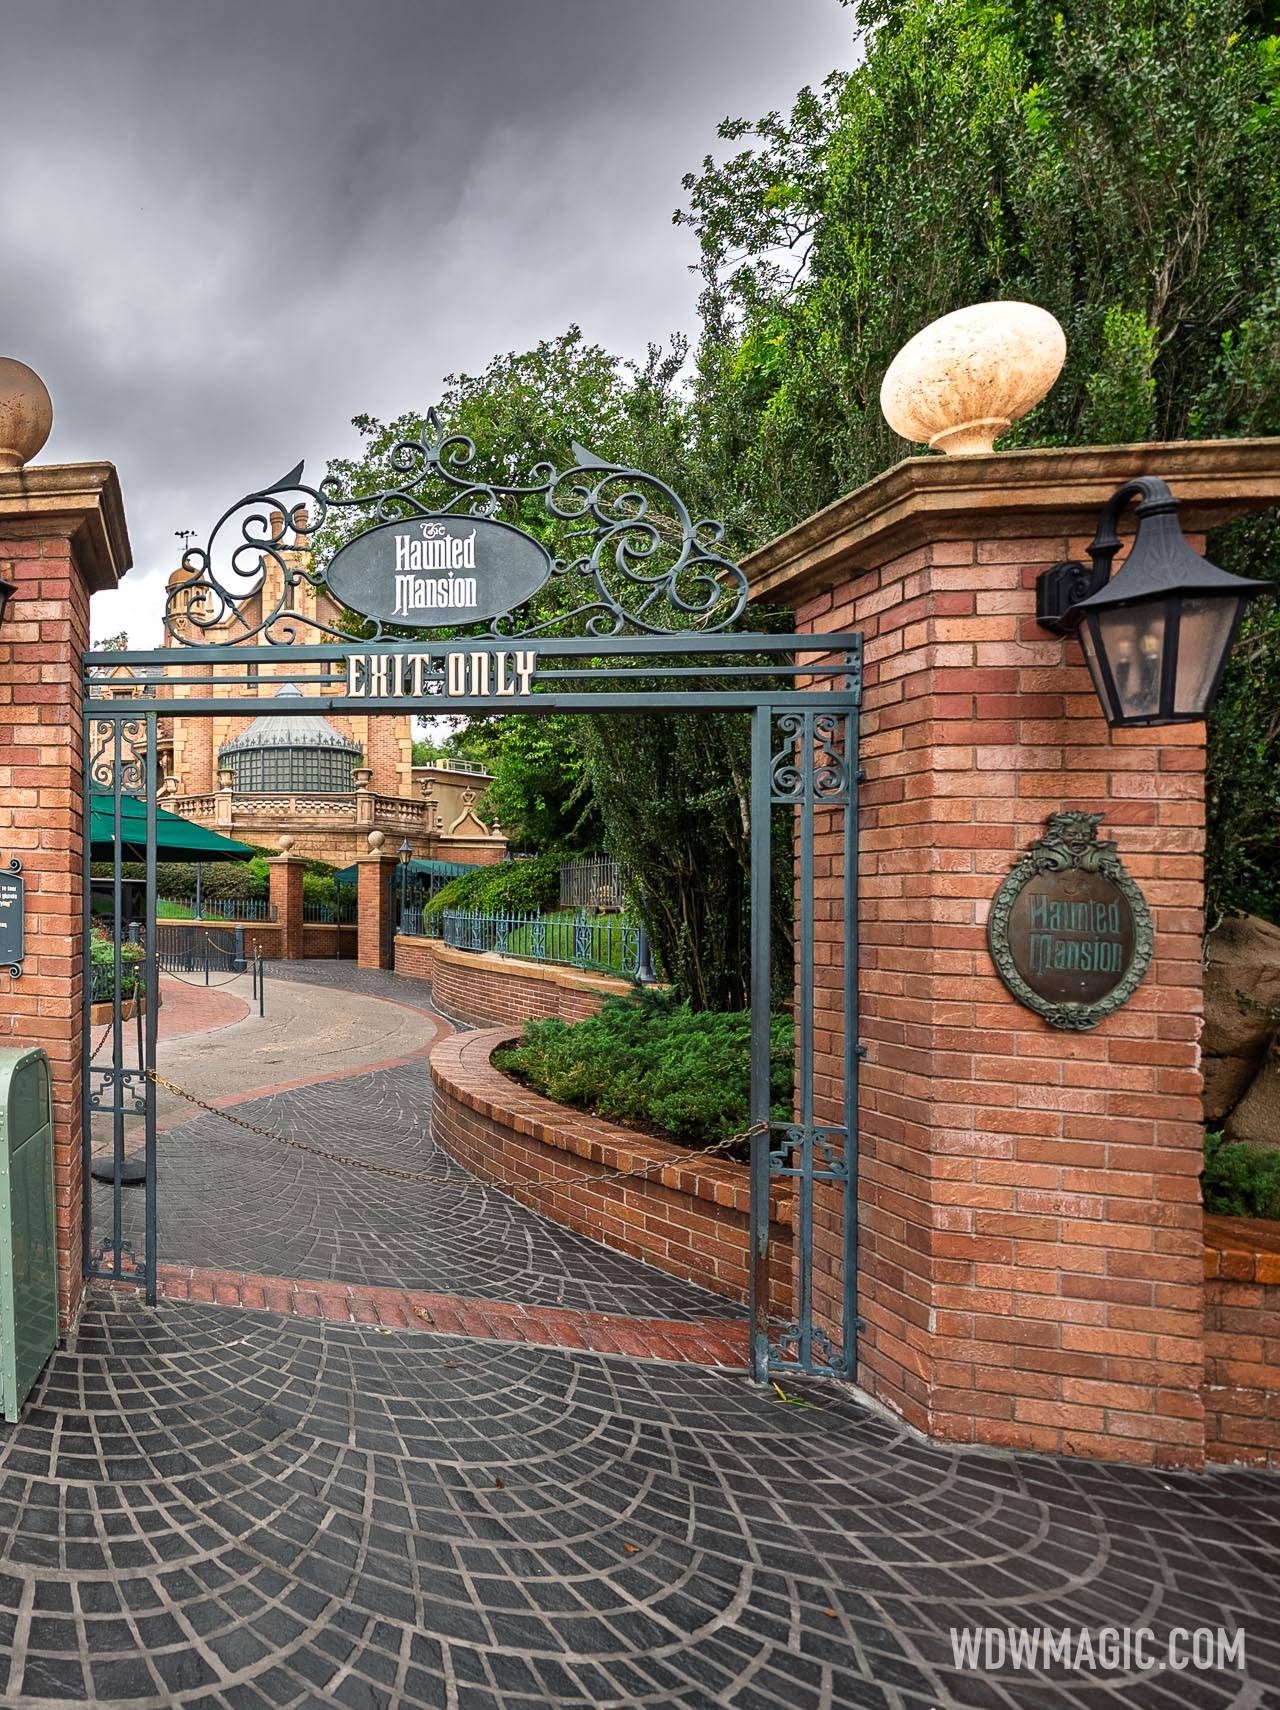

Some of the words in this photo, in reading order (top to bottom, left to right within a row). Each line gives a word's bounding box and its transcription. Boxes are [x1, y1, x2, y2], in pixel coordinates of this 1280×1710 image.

[394, 528, 477, 571] Haunted
[420, 522, 446, 539] The
[392, 571, 477, 616] Mansion
[346, 653, 431, 698] EXIT
[447, 651, 538, 698] ONLY
[1028, 894, 1121, 934] Haunted
[1028, 932, 1123, 977] Mansion
